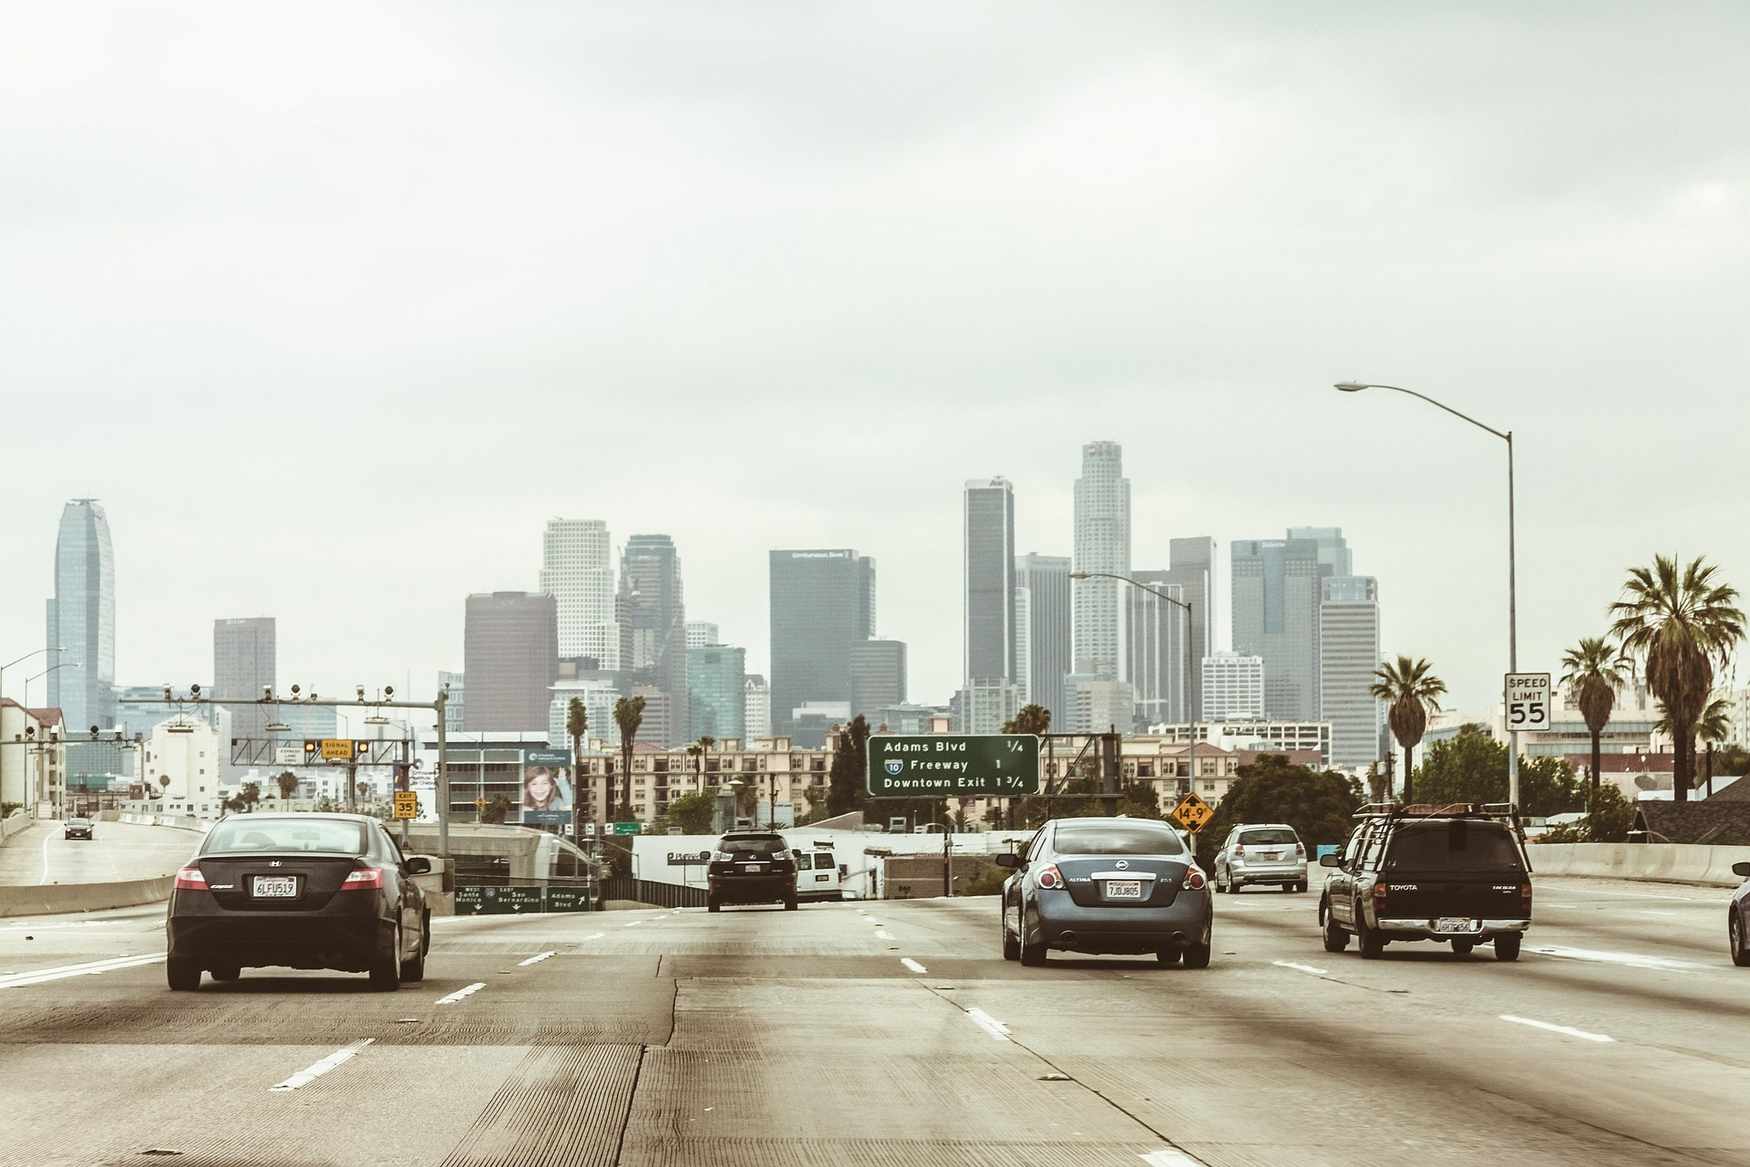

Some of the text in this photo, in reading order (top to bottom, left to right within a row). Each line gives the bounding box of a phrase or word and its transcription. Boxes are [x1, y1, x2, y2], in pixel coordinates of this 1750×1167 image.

[1509, 678, 1547, 688] SPEED
[1512, 691, 1542, 701] LIMIT
[1510, 702, 1545, 724] 55
[884, 742, 929, 752] Adams
[935, 741, 967, 752] Blvd
[889, 759, 1001, 773] 10 Freeway 1
[883, 777, 951, 788] Downtown
[957, 777, 985, 788] Exit
[996, 777, 1001, 787] 1
[399, 803, 413, 812] 35
[256, 883, 294, 894] 6LFU519
